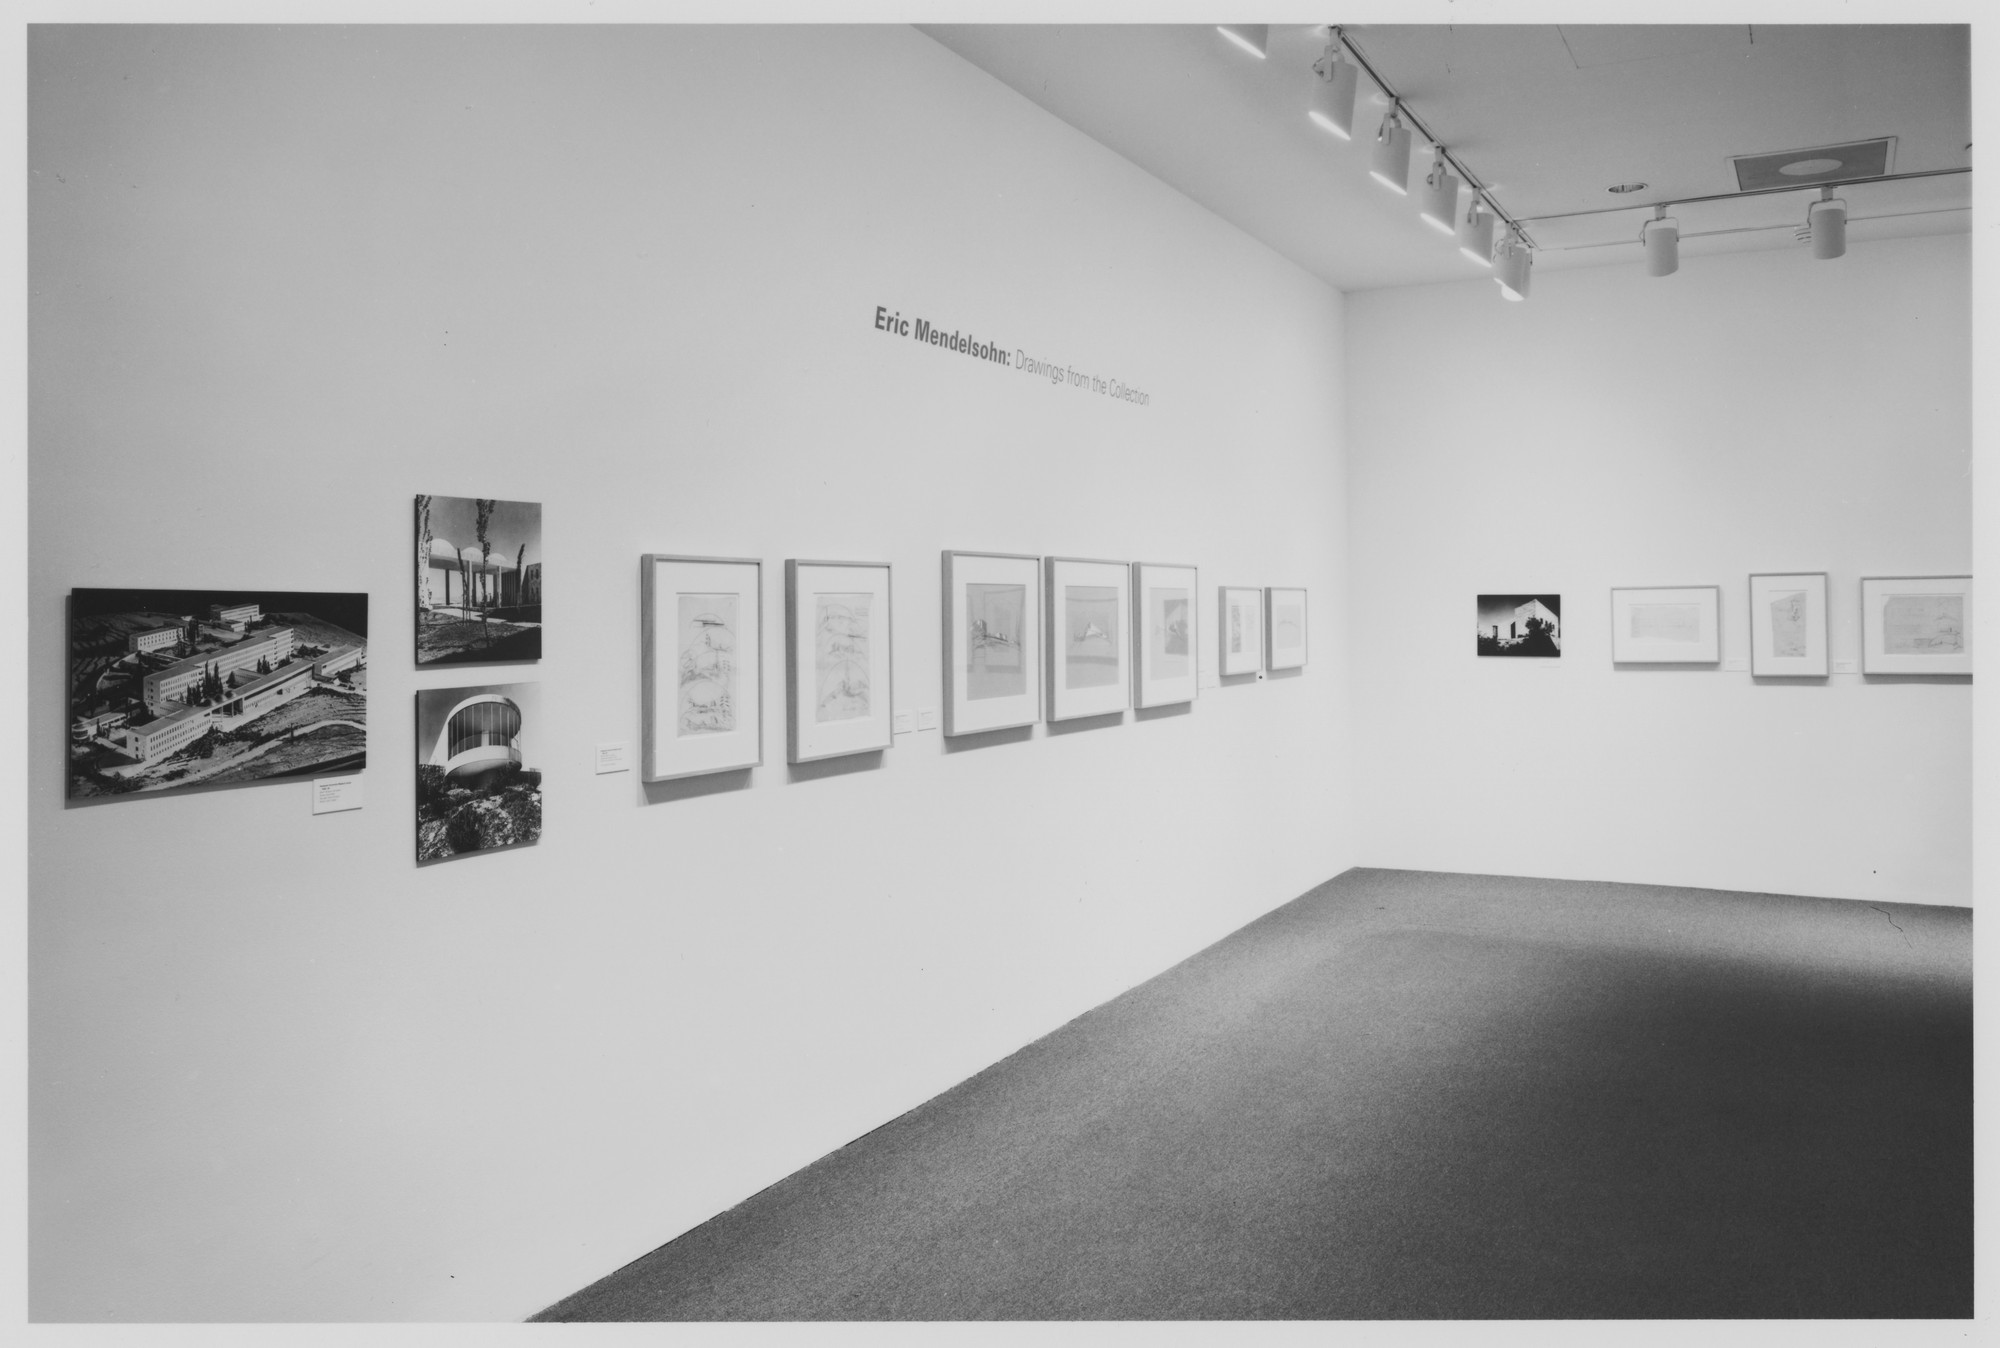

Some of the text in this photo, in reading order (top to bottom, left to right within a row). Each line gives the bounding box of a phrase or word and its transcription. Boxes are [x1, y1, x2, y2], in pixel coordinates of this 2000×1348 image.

[874, 305, 1150, 407] Eric Mendelsohn: Drawings from the Collection
